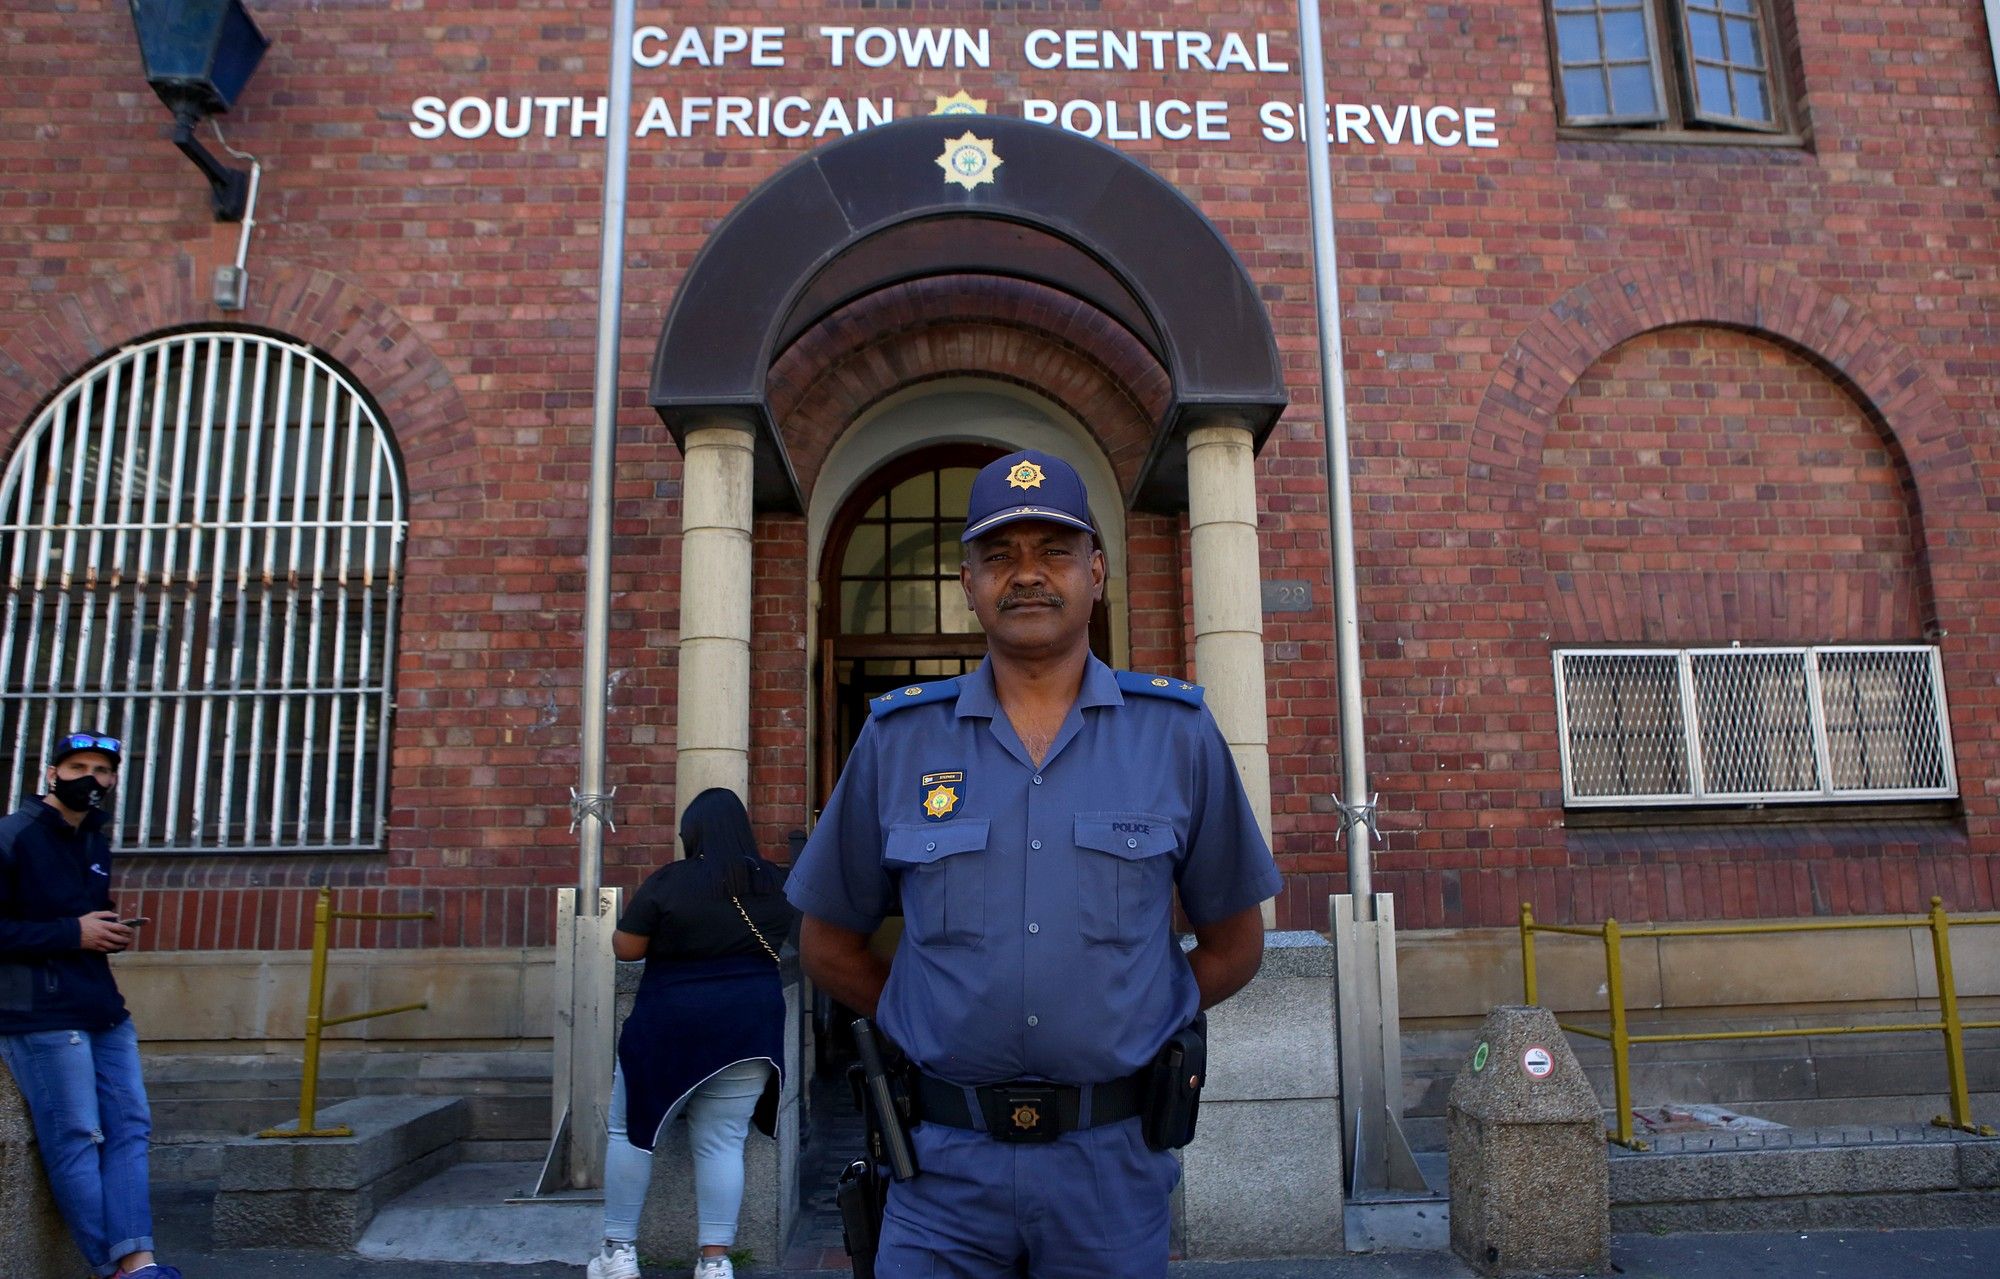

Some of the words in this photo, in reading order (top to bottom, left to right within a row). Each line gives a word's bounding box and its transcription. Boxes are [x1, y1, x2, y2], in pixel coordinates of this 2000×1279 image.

[631, 26, 786, 66] CAPE
[820, 26, 990, 67] TOWN
[1025, 29, 1289, 71] CENTRAL
[410, 96, 609, 138] SOUTH
[635, 97, 893, 137] AFRICAN
[1023, 99, 1231, 140] POLICE
[1112, 822, 1150, 835] POLICE
